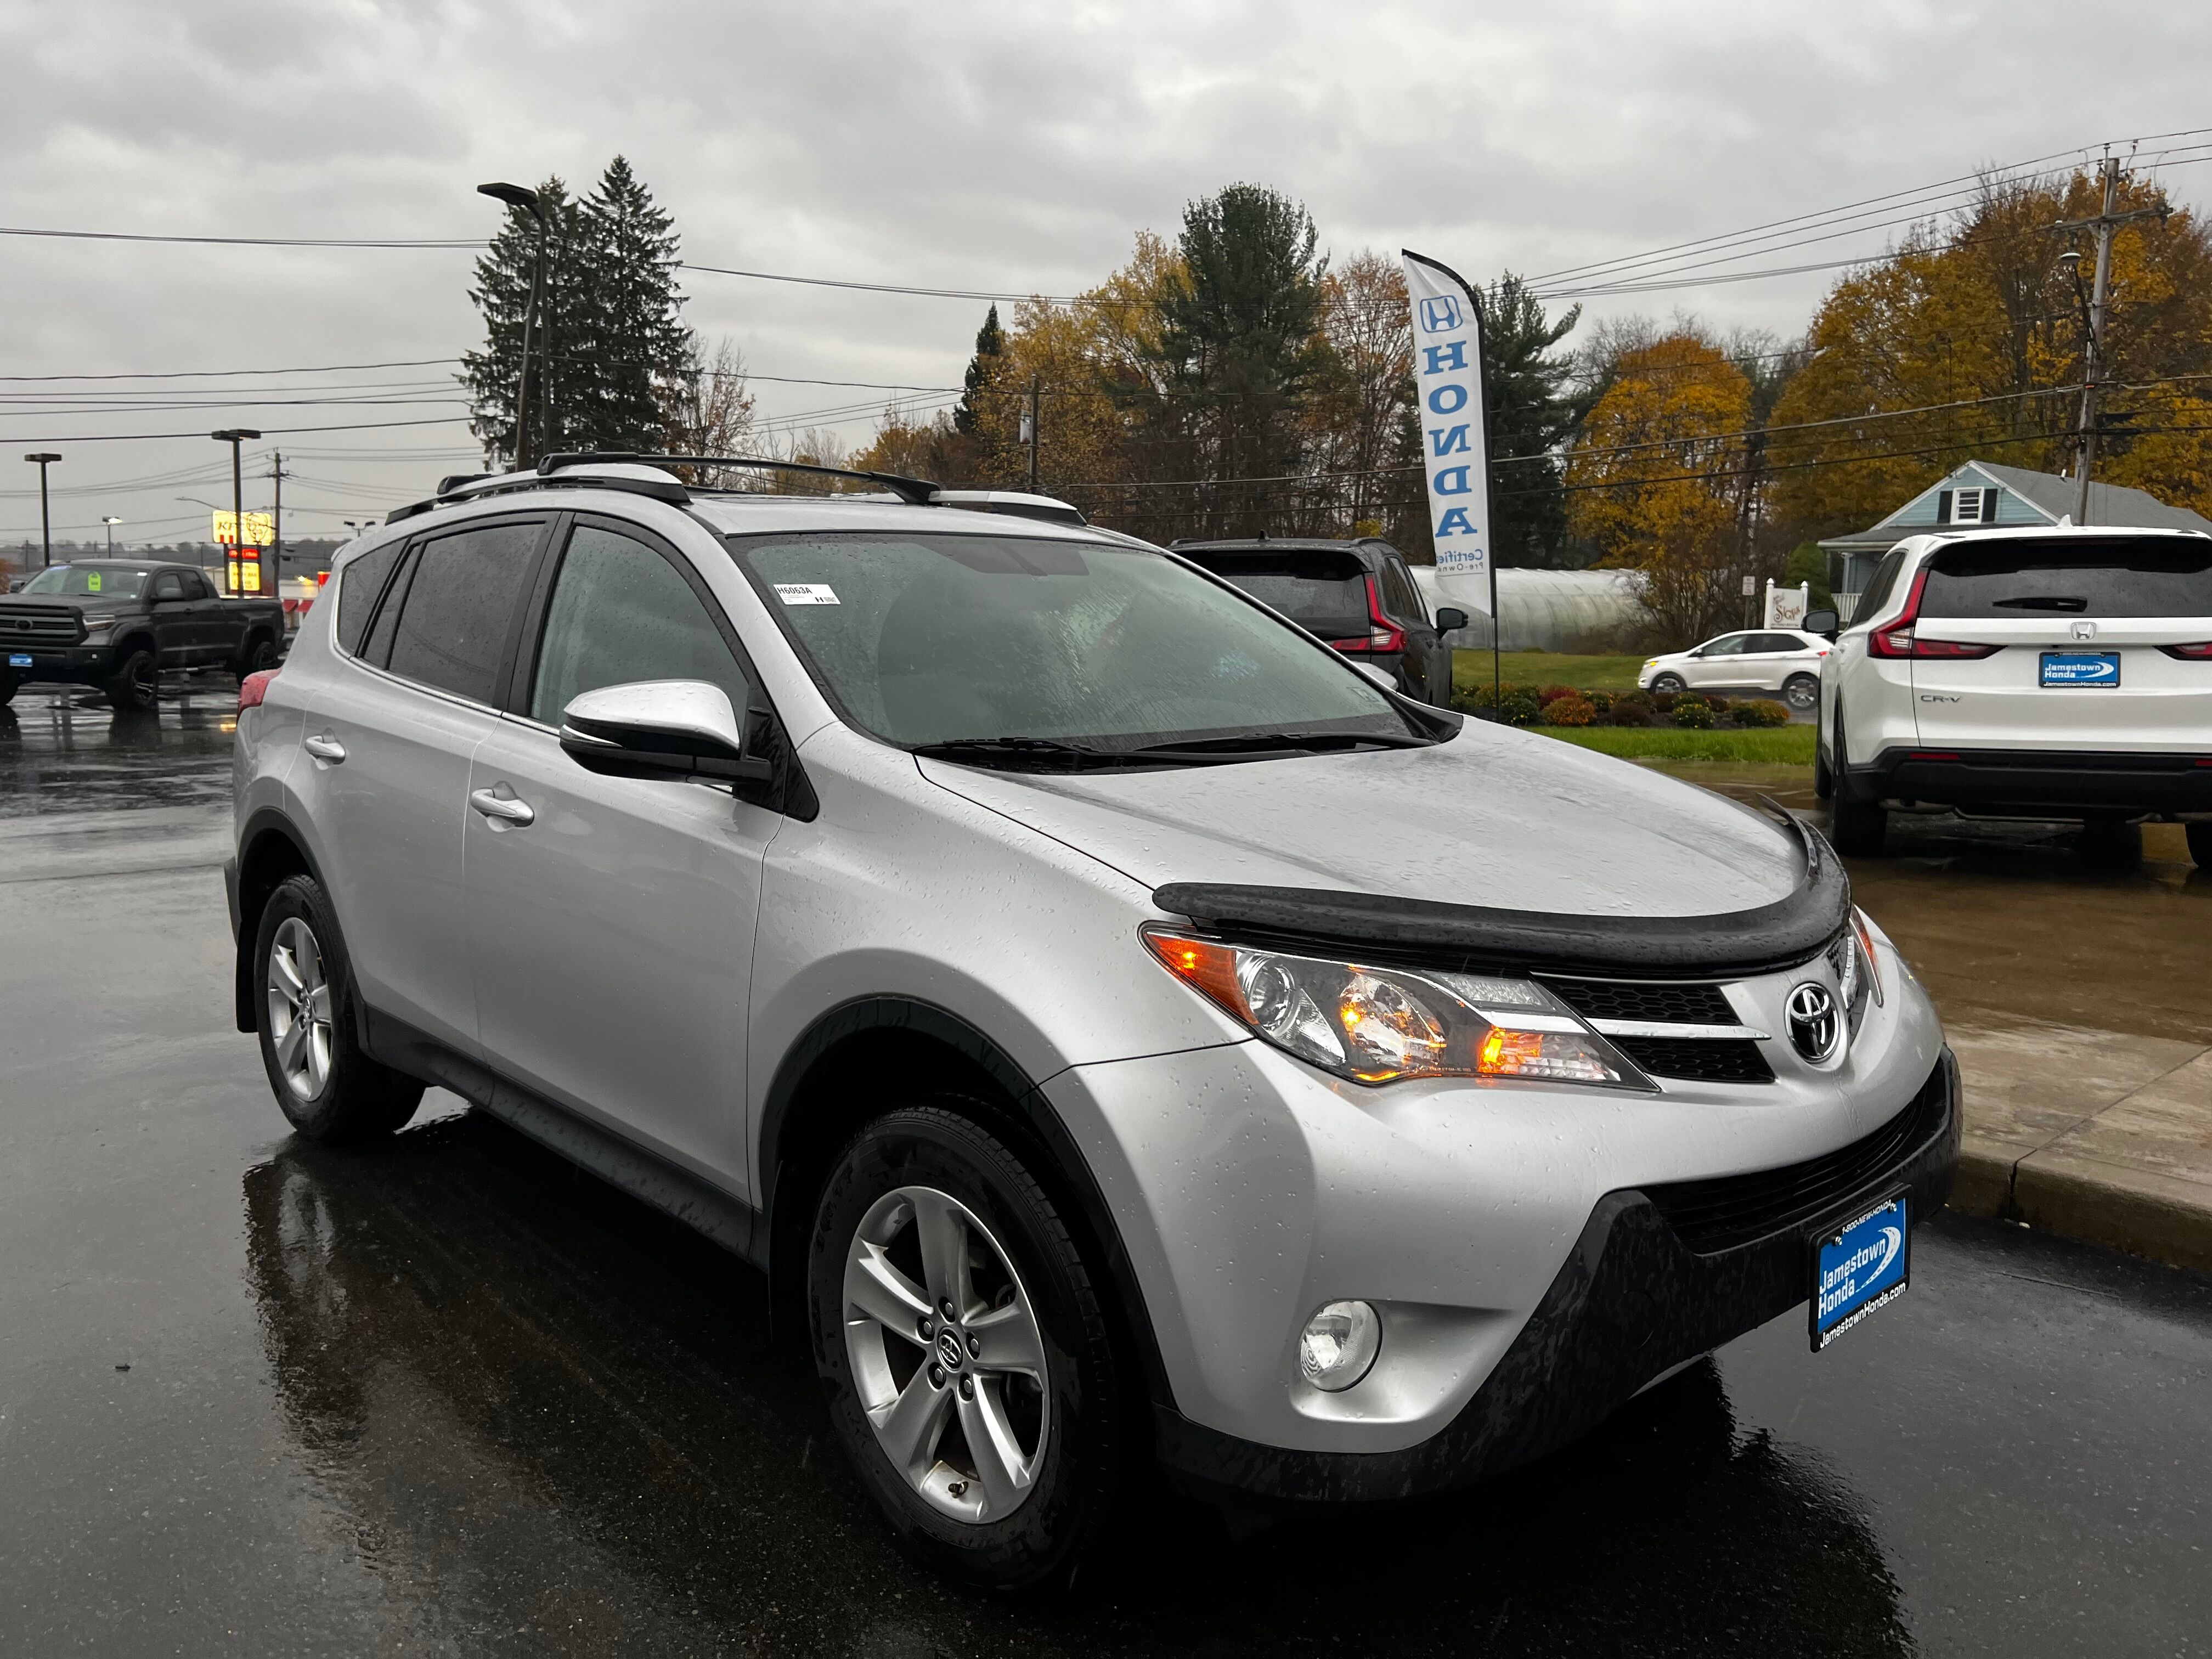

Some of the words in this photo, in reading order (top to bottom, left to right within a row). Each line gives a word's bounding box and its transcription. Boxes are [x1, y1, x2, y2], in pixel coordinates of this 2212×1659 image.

[1921, 695, 1961, 703] CR-V
[1819, 1238, 1886, 1295] Jamestown
[1818, 1277, 1855, 1319] Honda
[1820, 1282, 1906, 1348] JamestownHonda.com
